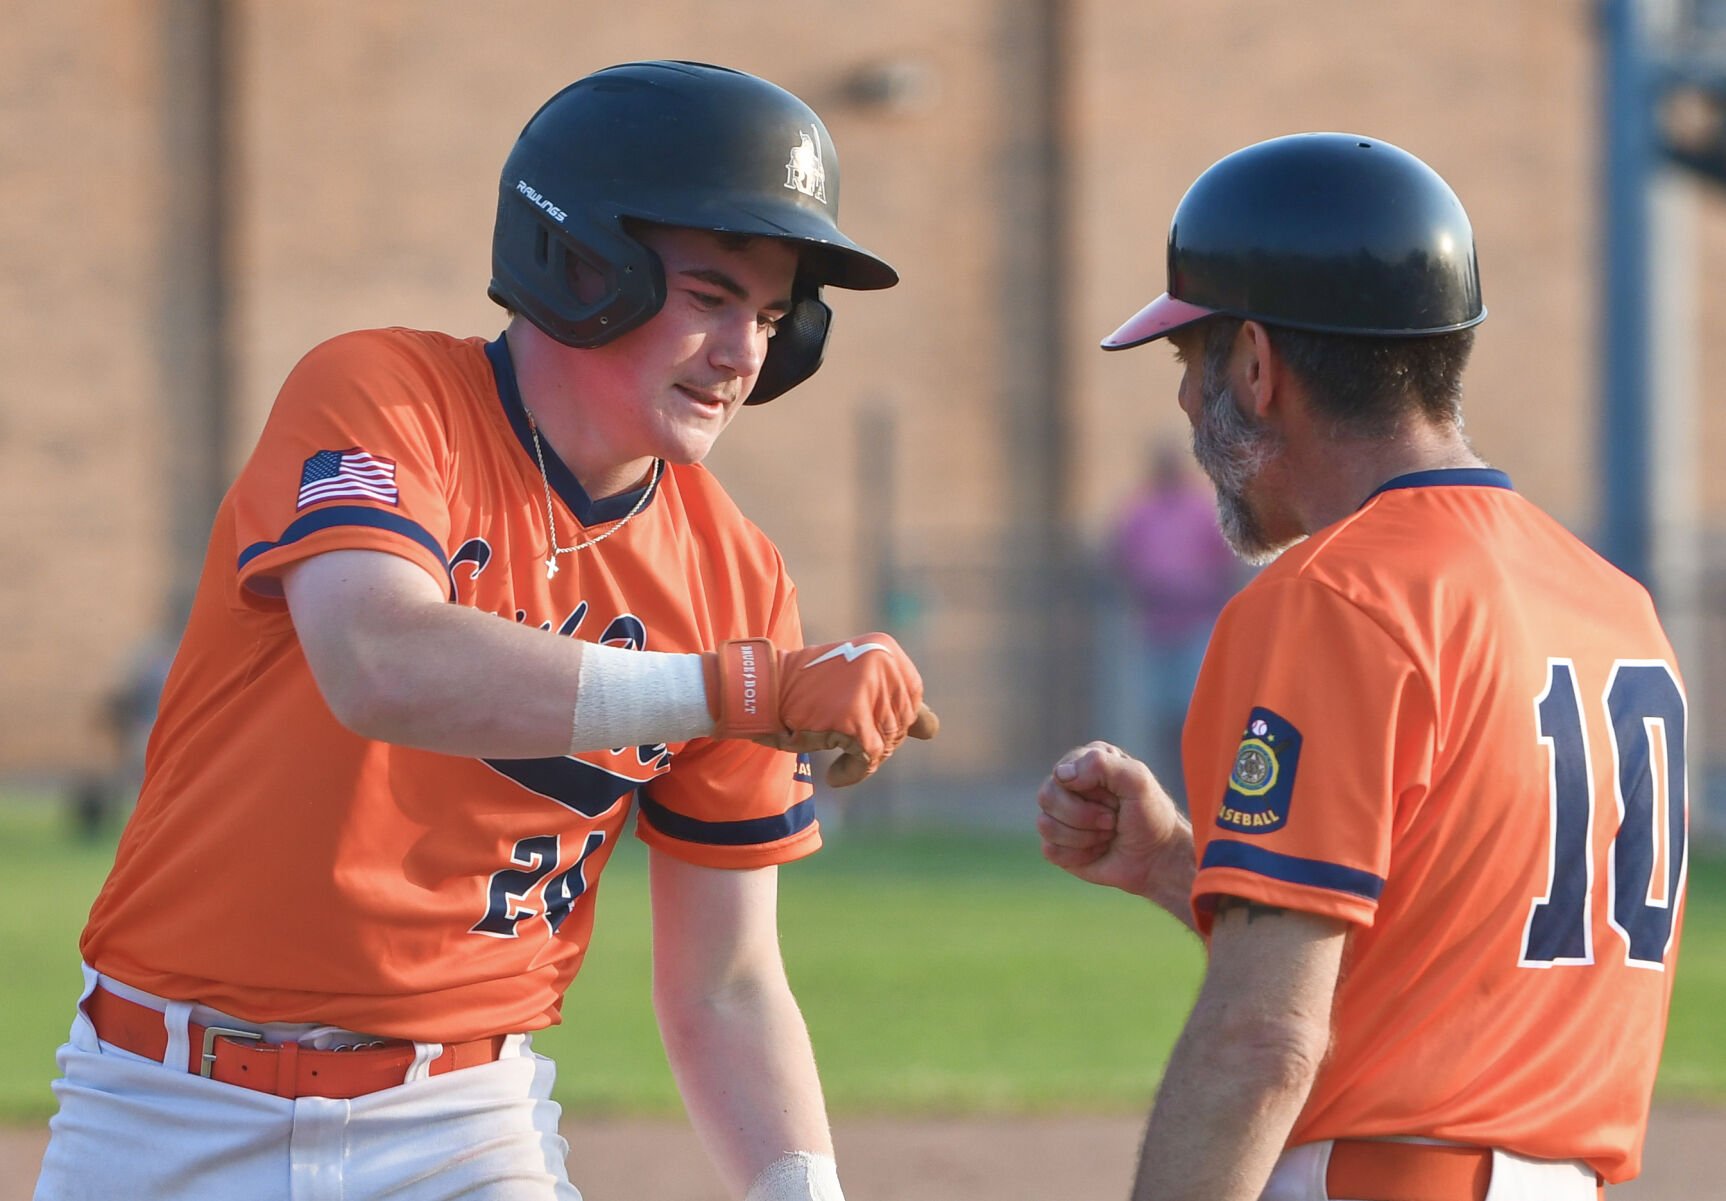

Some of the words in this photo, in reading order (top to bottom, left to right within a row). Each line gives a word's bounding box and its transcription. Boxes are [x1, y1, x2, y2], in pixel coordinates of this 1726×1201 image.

[517, 180, 568, 223] RAWLINGS
[744, 680, 756, 714] BOLT
[1516, 656, 1689, 973] 10
[466, 830, 606, 939] 24
